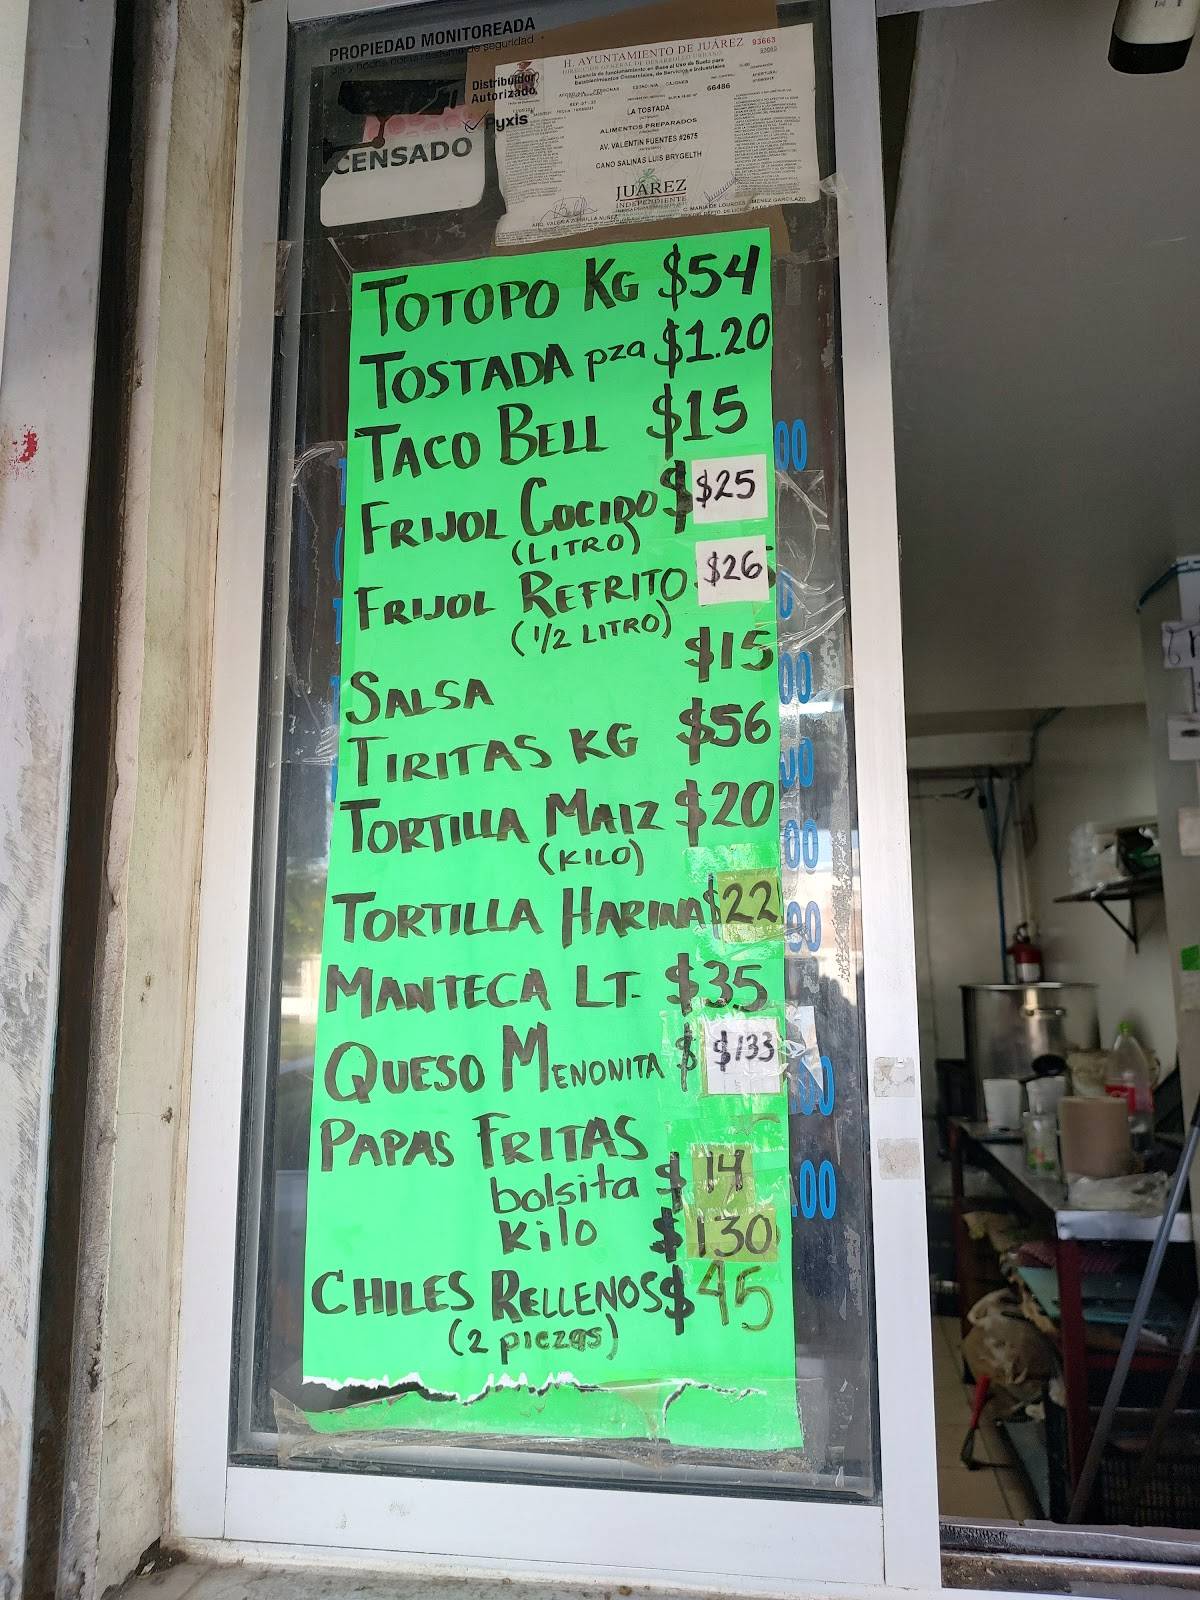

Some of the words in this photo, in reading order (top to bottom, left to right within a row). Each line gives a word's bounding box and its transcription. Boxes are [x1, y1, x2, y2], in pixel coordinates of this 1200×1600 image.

[329, 36, 416, 61] PROPIEDAD
[421, 17, 536, 47] MONITOREADA
[483, 35, 534, 51] seguridad
[578, 47, 674, 66] AYUNTAMIENTO
[678, 44, 694, 54] DE
[472, 74, 536, 91] Distribuidor
[706, 82, 731, 91] 66486
[485, 113, 528, 132] Pyxis
[600, 123, 643, 134] ALIMENTOS
[645, 117, 698, 129] PREPARADOS
[627, 105, 636, 115] LA
[637, 104, 670, 114] TOSTADA
[334, 137, 473, 175] CENSADO
[611, 139, 645, 149] VALENTIN
[646, 135, 678, 145] FUENTES
[617, 156, 647, 167] SALINAS
[616, 195, 687, 209] INDEPENDIENTE
[361, 274, 560, 336] TOTOPO
[584, 257, 640, 313] KG
[658, 244, 761, 311] $54
[359, 343, 574, 409] TOSTADA
[584, 340, 646, 382] pza
[654, 312, 771, 378] $1.20
[354, 424, 480, 483] TACO
[497, 403, 609, 465] BELL
[646, 383, 748, 461] $15
[695, 469, 756, 508] $25
[360, 500, 508, 555] FRIJOL
[520, 477, 658, 537] COCIDO
[511, 519, 640, 566] (LITRO)
[704, 550, 763, 587] $26
[354, 585, 496, 632] FRIJOL
[519, 568, 687, 618] REFRITO
[510, 621, 568, 657] (1/2
[582, 600, 672, 645] LITRO)
[346, 671, 495, 725] SALSA
[684, 626, 774, 683] $15
[349, 734, 552, 787] TIRITAS
[569, 723, 639, 764] KG
[678, 697, 772, 765] $56
[340, 799, 530, 853] TORTILLA
[545, 788, 666, 838] MAIZ
[674, 779, 775, 847] $20
[538, 839, 644, 877] (KILO)
[333, 891, 544, 944] TORTILLA
[561, 886, 704, 950] HARINA
[325, 964, 553, 1019] MANTECA
[664, 952, 768, 1016] $35
[324, 1040, 485, 1104] QUESO
[502, 1022, 665, 1093] MENONITA
[713, 1030, 775, 1072] $133
[320, 1118, 456, 1172] PAPAS
[473, 1113, 649, 1169] FRITAS
[490, 1163, 640, 1215] bolsita
[311, 1269, 474, 1317] CHILES
[492, 1270, 663, 1324] RELLENOS
[449, 1319, 489, 1357] (2
[500, 1315, 618, 1364] piezas)
